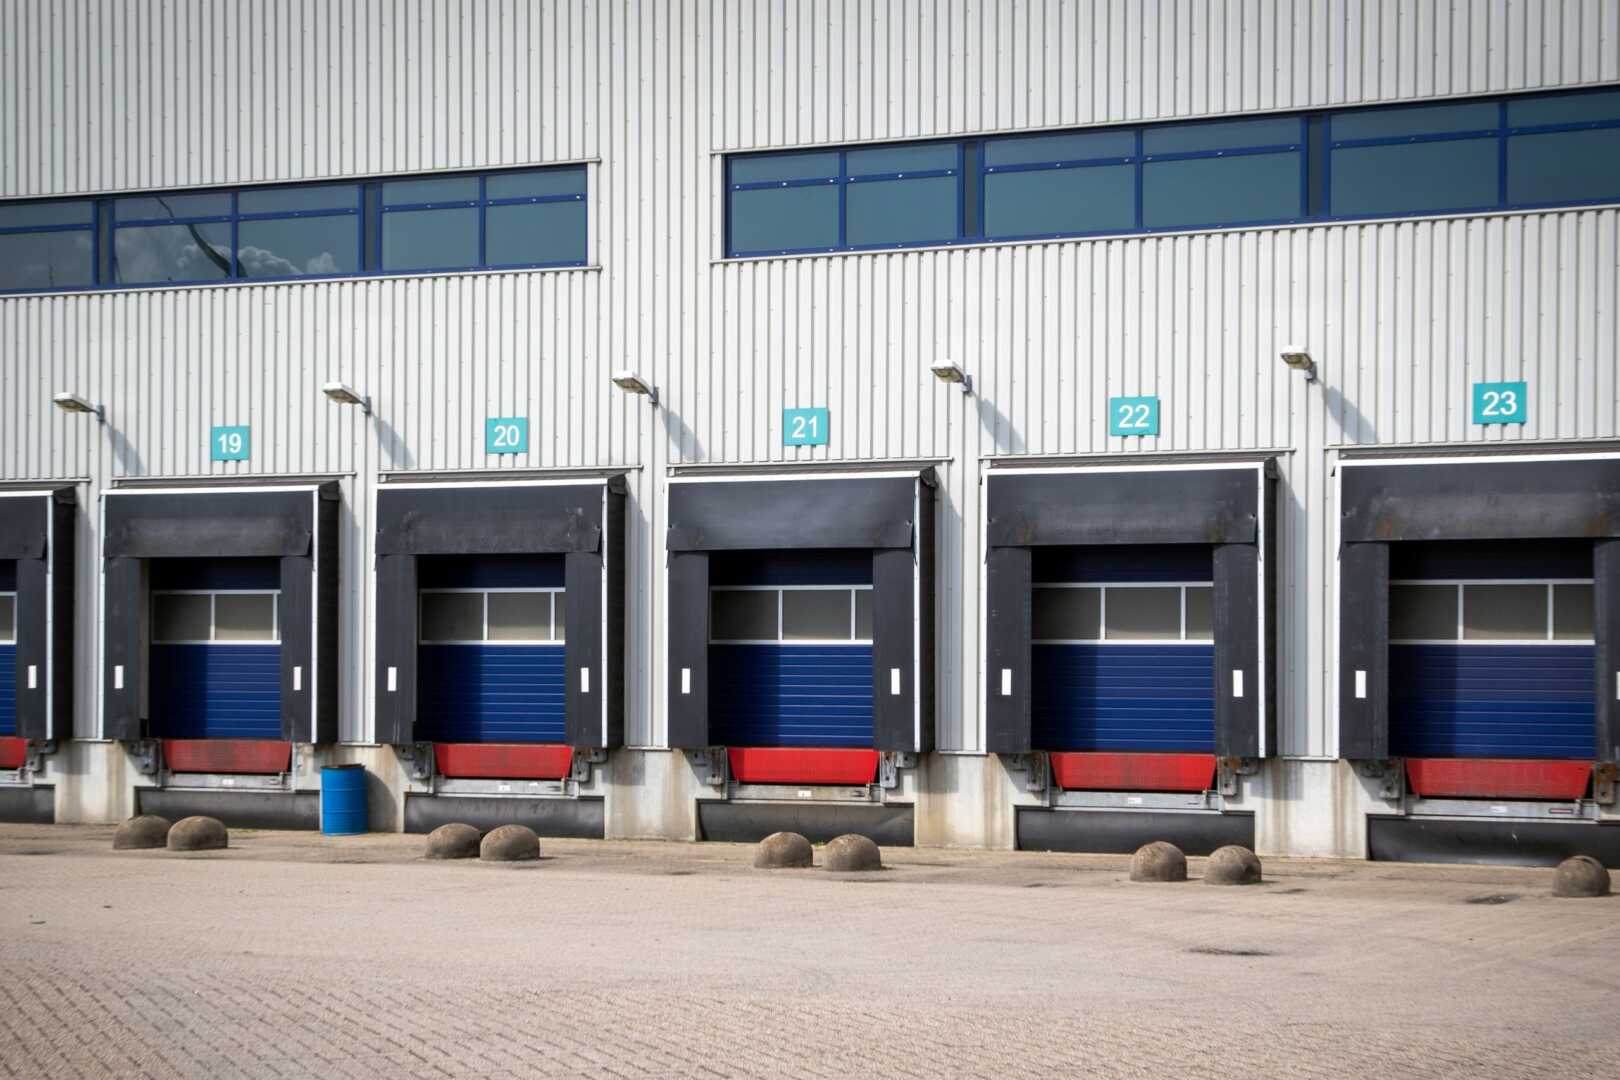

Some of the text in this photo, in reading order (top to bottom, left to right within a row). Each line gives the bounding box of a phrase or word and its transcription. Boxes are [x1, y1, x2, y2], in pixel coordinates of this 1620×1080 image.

[1483, 390, 1518, 416] 23
[791, 415, 817, 439] 21
[1118, 404, 1150, 429] 22
[218, 433, 242, 454] 19
[493, 425, 520, 447] 20
